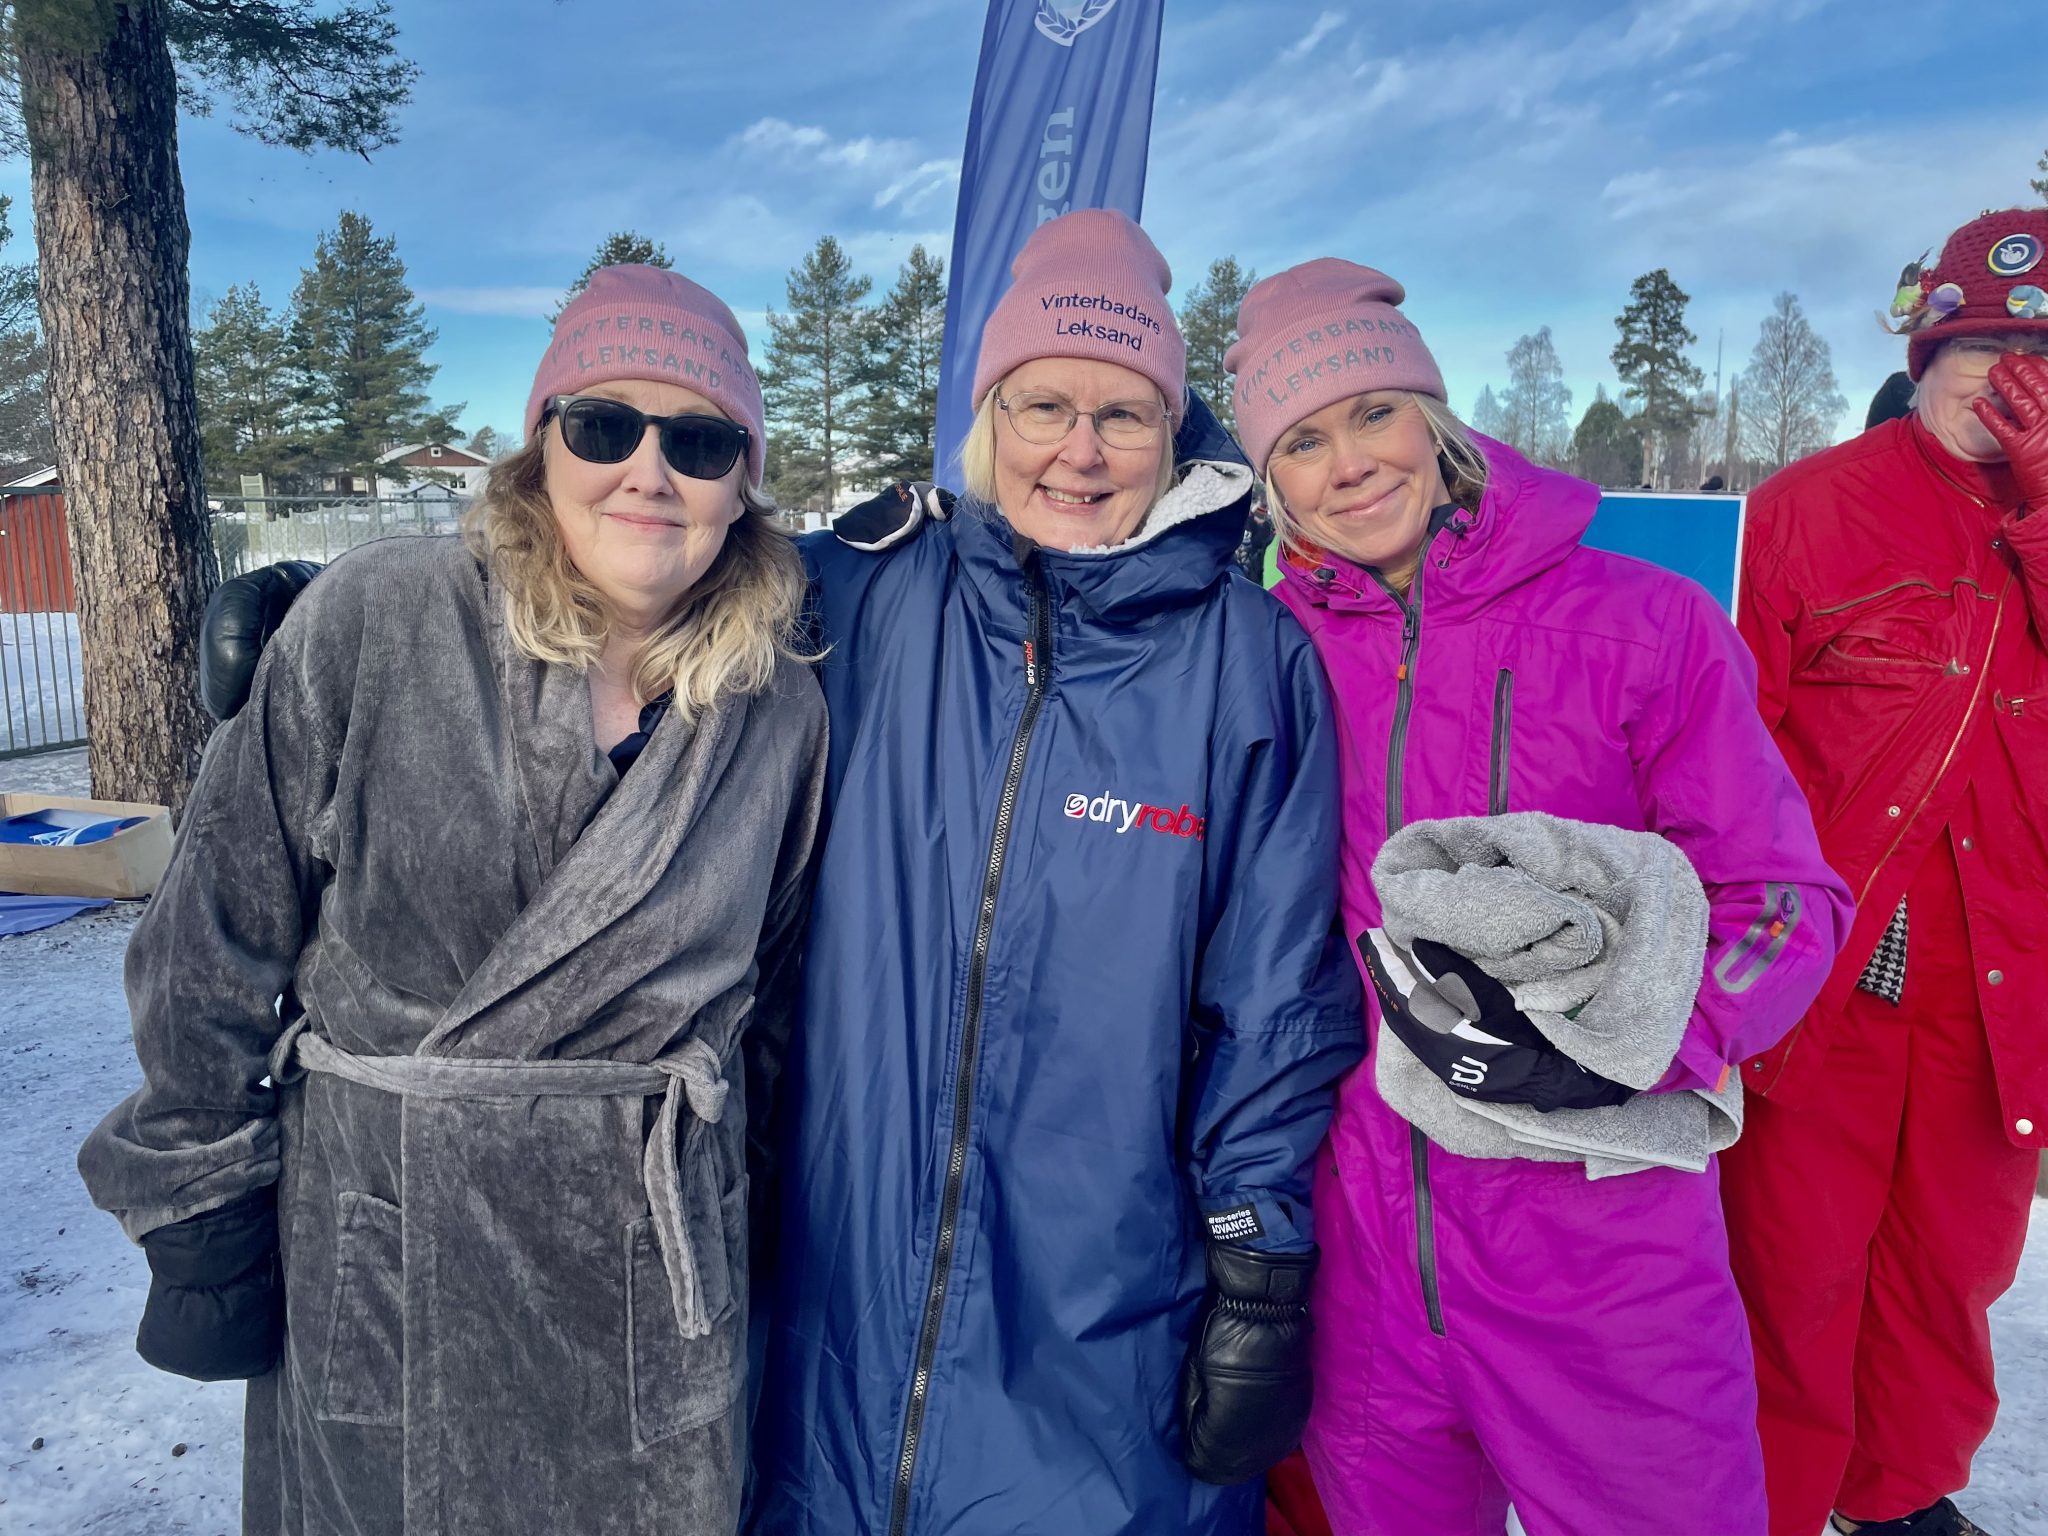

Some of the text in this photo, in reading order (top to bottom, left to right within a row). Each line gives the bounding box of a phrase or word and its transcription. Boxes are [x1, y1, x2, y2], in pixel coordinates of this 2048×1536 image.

[1041, 293, 1161, 335] Vinterbadare
[1056, 318, 1142, 351] Leksand
[577, 344, 721, 388] LEKSAND
[1266, 346, 1395, 406] LEKSAND
[1211, 1216, 1256, 1235] ADVANCE
